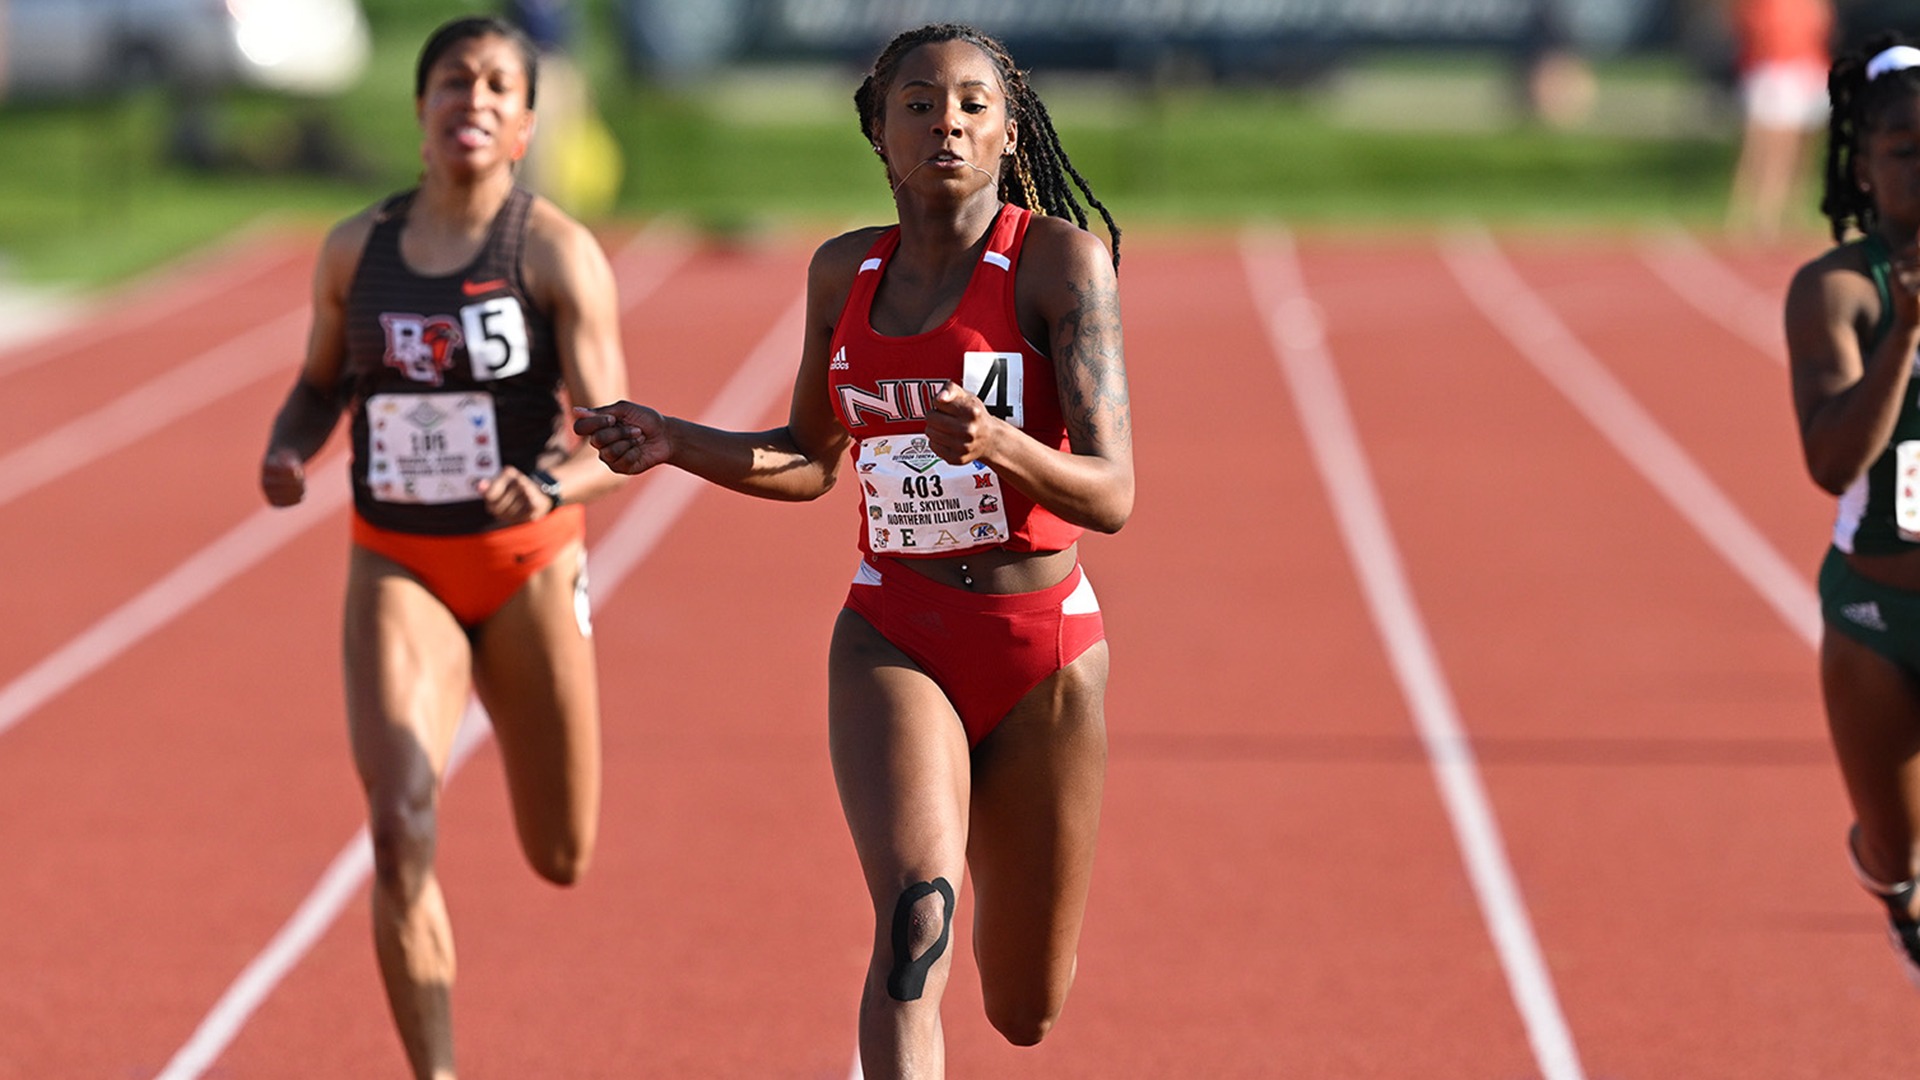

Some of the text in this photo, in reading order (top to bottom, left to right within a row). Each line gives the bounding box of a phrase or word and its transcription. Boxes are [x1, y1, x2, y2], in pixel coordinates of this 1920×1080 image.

[480, 310, 511, 371] 5
[975, 358, 1013, 421] 4
[902, 474, 944, 499] 403
[972, 473, 993, 489] M
[894, 498, 960, 514] BLUE, SKYLYNN
[887, 508, 975, 525] NORTHERN ILLINOIS
[900, 528, 917, 547] E
[934, 529, 960, 546] A
